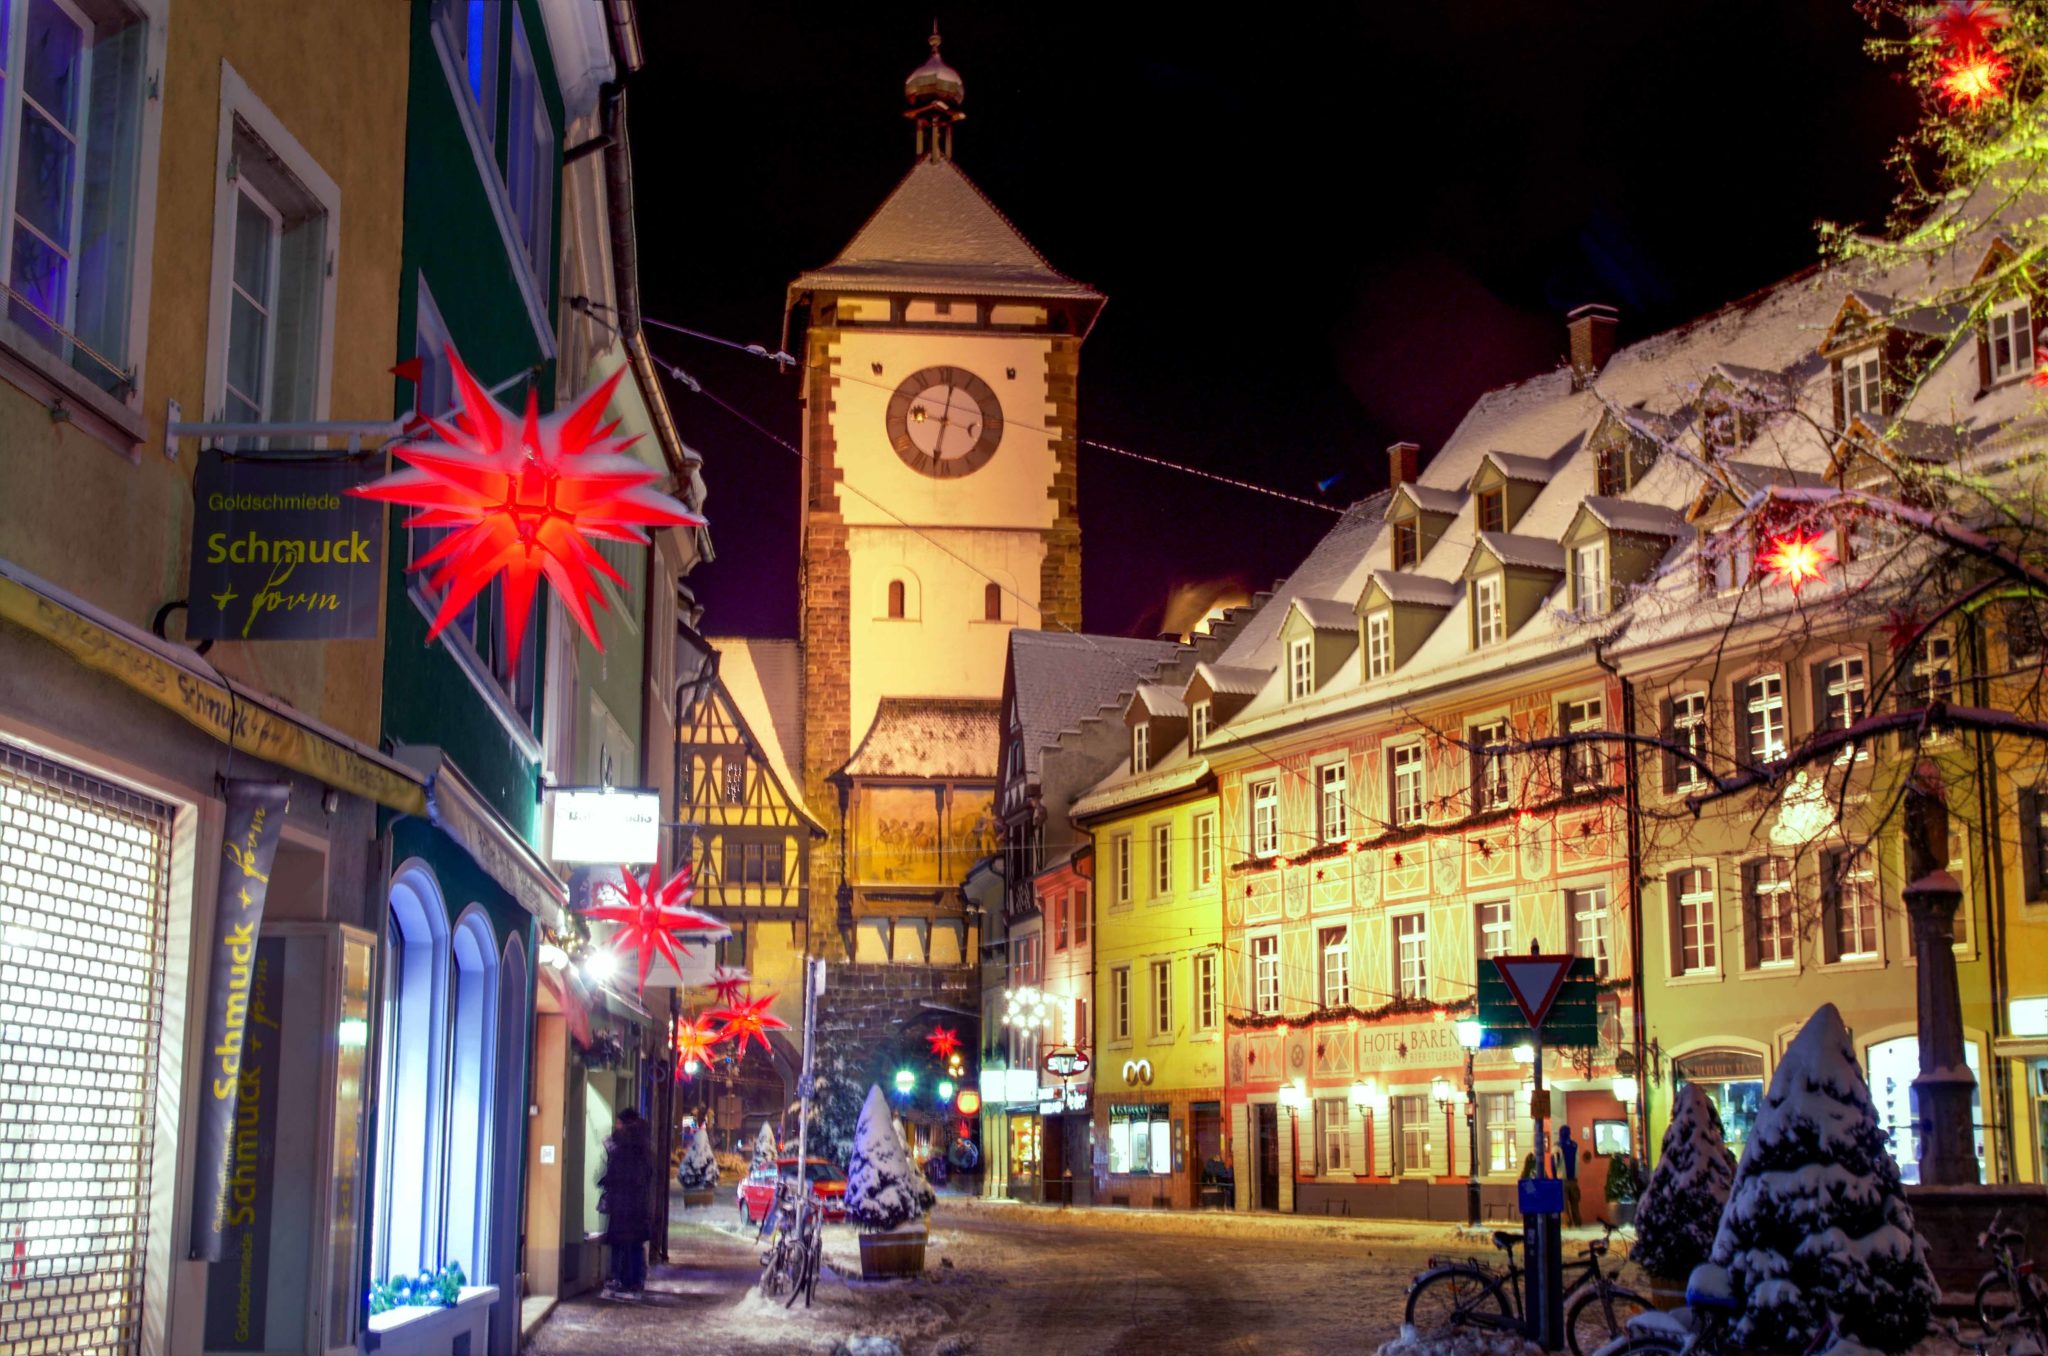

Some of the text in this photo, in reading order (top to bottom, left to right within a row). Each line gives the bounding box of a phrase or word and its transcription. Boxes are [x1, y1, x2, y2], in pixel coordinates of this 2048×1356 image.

[208, 492, 341, 511] Goldschmiede
[207, 530, 371, 565] Schmuck
[213, 921, 254, 1101] Schmuck
[1363, 1031, 1406, 1053] HOTEL
[227, 1065, 262, 1227] Schmuck
